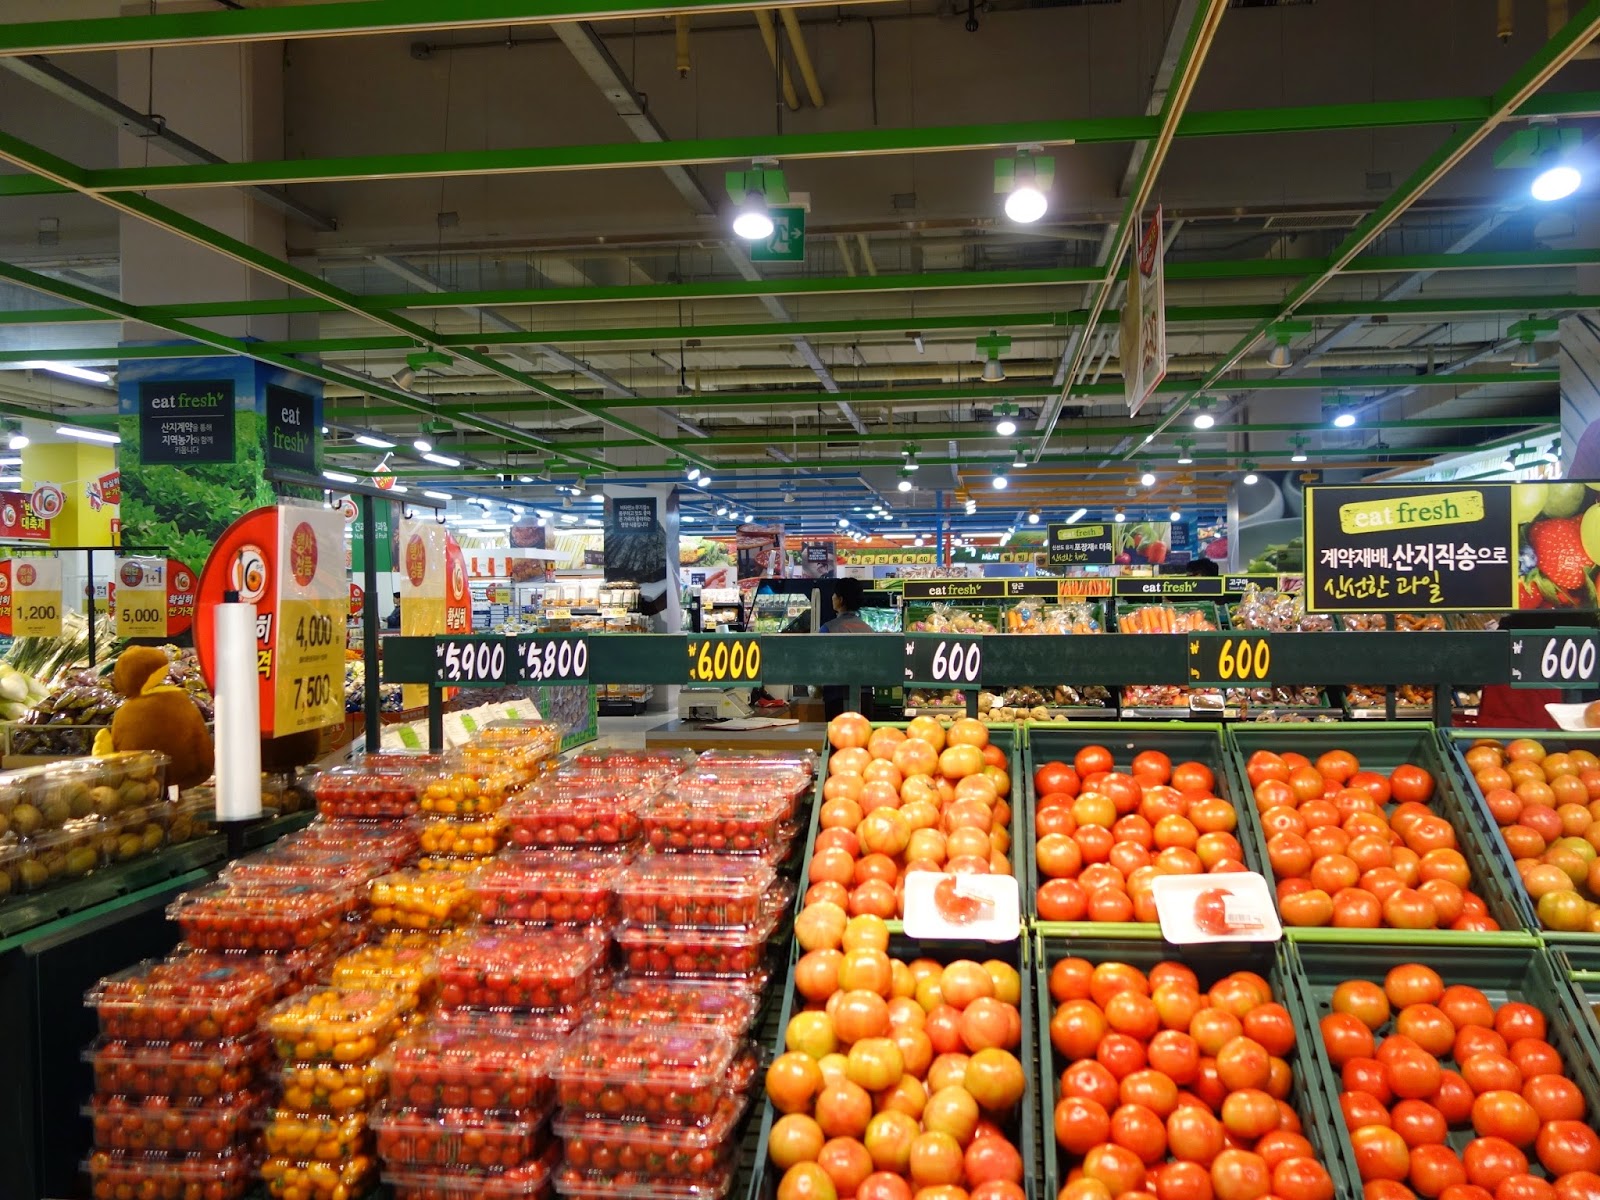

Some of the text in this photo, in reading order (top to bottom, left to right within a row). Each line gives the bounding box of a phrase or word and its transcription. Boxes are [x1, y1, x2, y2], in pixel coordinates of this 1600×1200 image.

[152, 392, 218, 409] eat fresh
[161, 421, 199, 434] 산지계약을
[281, 407, 301, 426] eat
[161, 434, 214, 446] 지역농가와 함께
[273, 426, 305, 453] fresh
[21, 516, 46, 531] 대축제
[1354, 498, 1460, 528] eat fresh
[1320, 543, 1508, 571] 계약재배, 산지직송으로
[169, 594, 193, 605] 확실히
[929, 583, 977, 595] eat fresh
[1142, 581, 1193, 593] eat fresh
[1324, 570, 1444, 603] 신선한 과일
[16, 605, 55, 621] 1,200
[122, 608, 159, 624] 5,000
[447, 607, 467, 629] 확실히
[296, 614, 332, 652] 4,000
[257, 648, 273, 679] 격
[445, 641, 505, 682] 5,900
[527, 639, 587, 682] 5,800
[698, 640, 760, 682] 6,000
[932, 641, 980, 681] 600
[1218, 639, 1270, 679] 600
[1541, 637, 1596, 680] 600
[293, 673, 330, 713] 7,500
